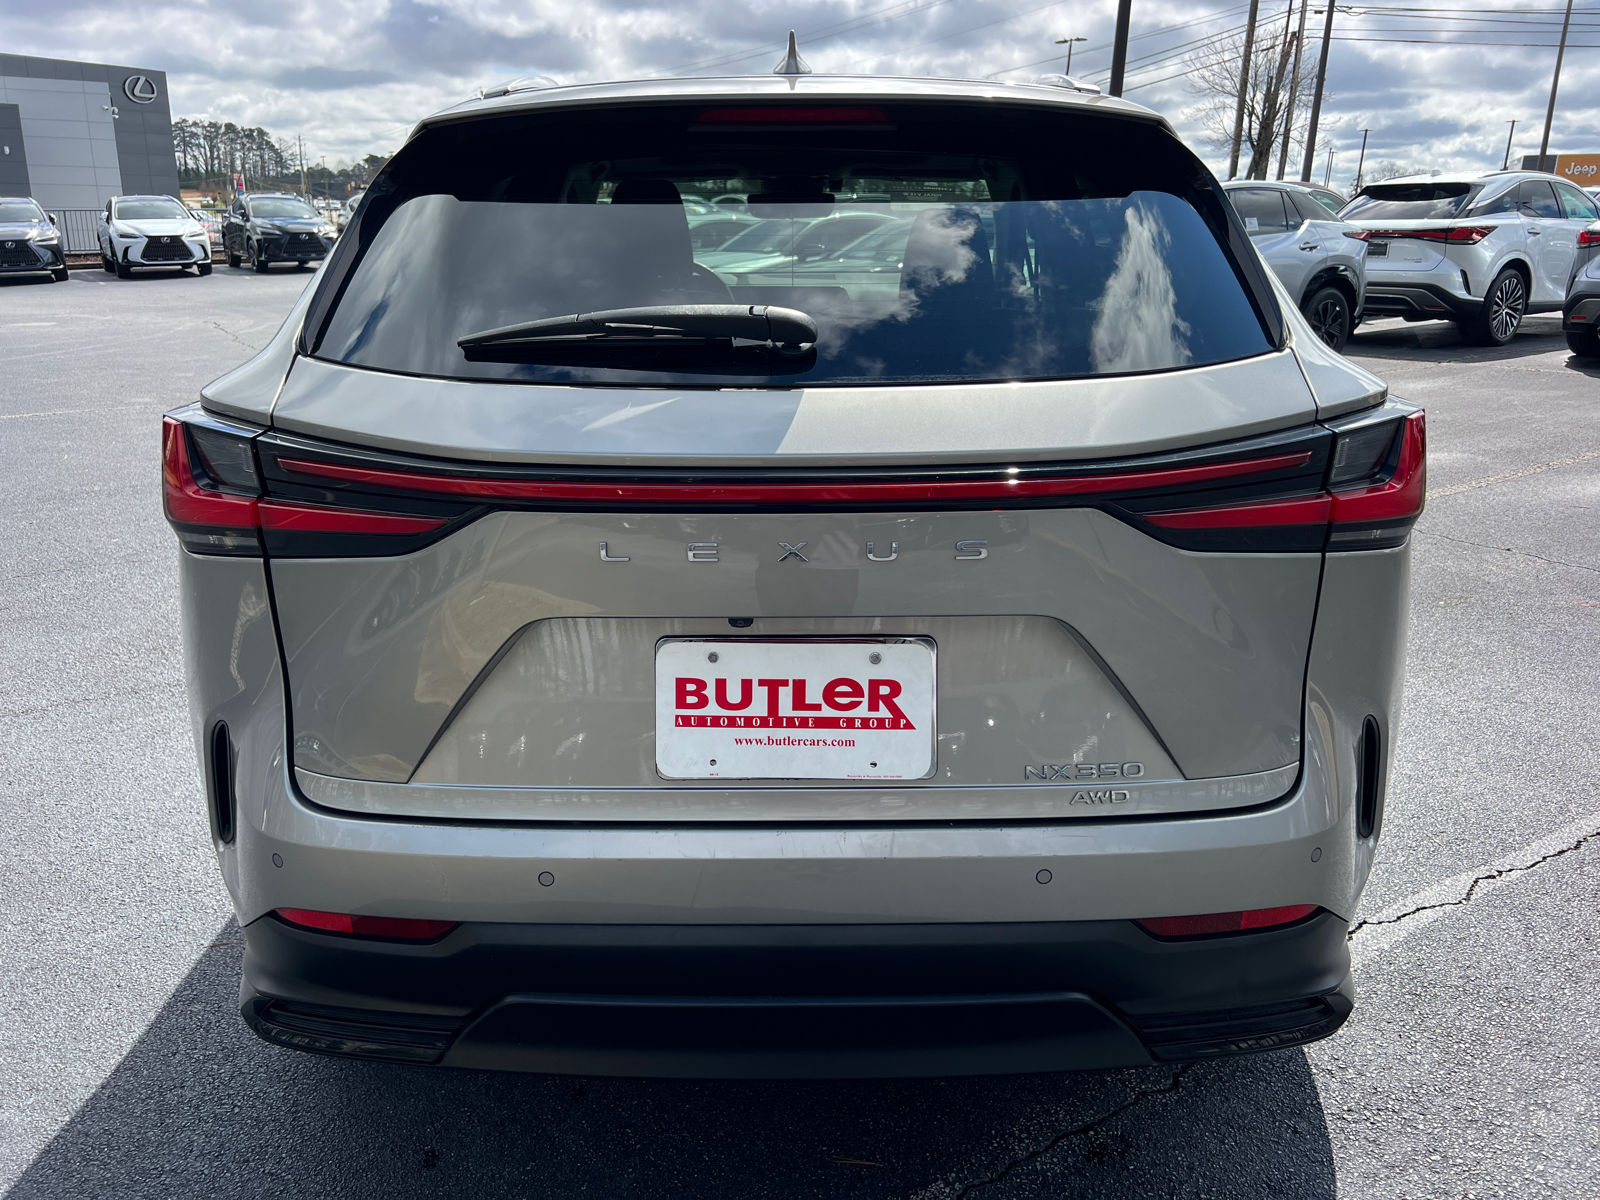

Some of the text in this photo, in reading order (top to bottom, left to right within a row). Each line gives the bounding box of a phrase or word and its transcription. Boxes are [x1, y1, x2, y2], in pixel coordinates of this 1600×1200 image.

[1565, 162, 1598, 177] Jeep
[599, 540, 989, 563] LEXUS
[676, 716, 907, 729] AUTOMOTIVE GROUP
[734, 735, 856, 748] www.butlercars.com
[1069, 790, 1130, 806] AWD
